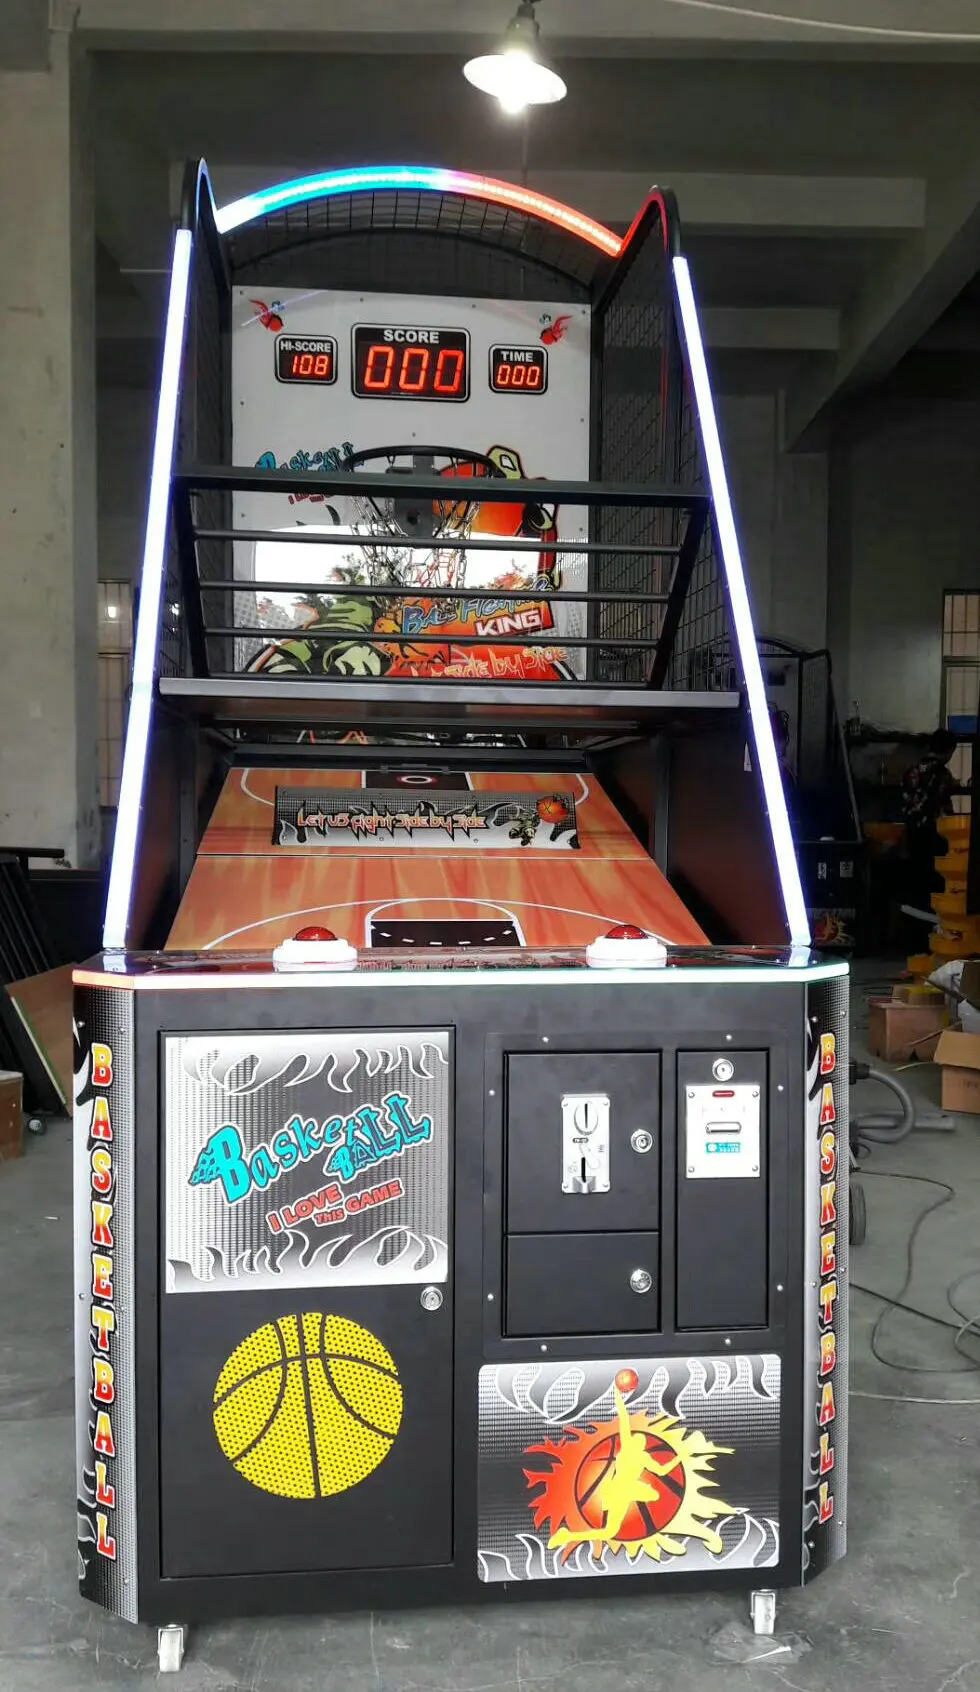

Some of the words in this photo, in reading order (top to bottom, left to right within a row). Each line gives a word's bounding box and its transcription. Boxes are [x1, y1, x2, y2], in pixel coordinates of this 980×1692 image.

[280, 340, 332, 353] HI-SCORE
[383, 329, 439, 344] SCORE
[292, 354, 329, 375] 108
[364, 345, 464, 392] 000
[500, 350, 534, 363] TIME
[496, 364, 540, 386] 000
[475, 609, 540, 636] KING
[188, 1115, 362, 1205] Basket
[267, 1212, 281, 1232] I
[282, 1183, 343, 1226] LOVE
[345, 1180, 404, 1213] GAME
[819, 1033, 838, 1523] BASKETBALL
[91, 1043, 116, 1559] BASKETBALL
